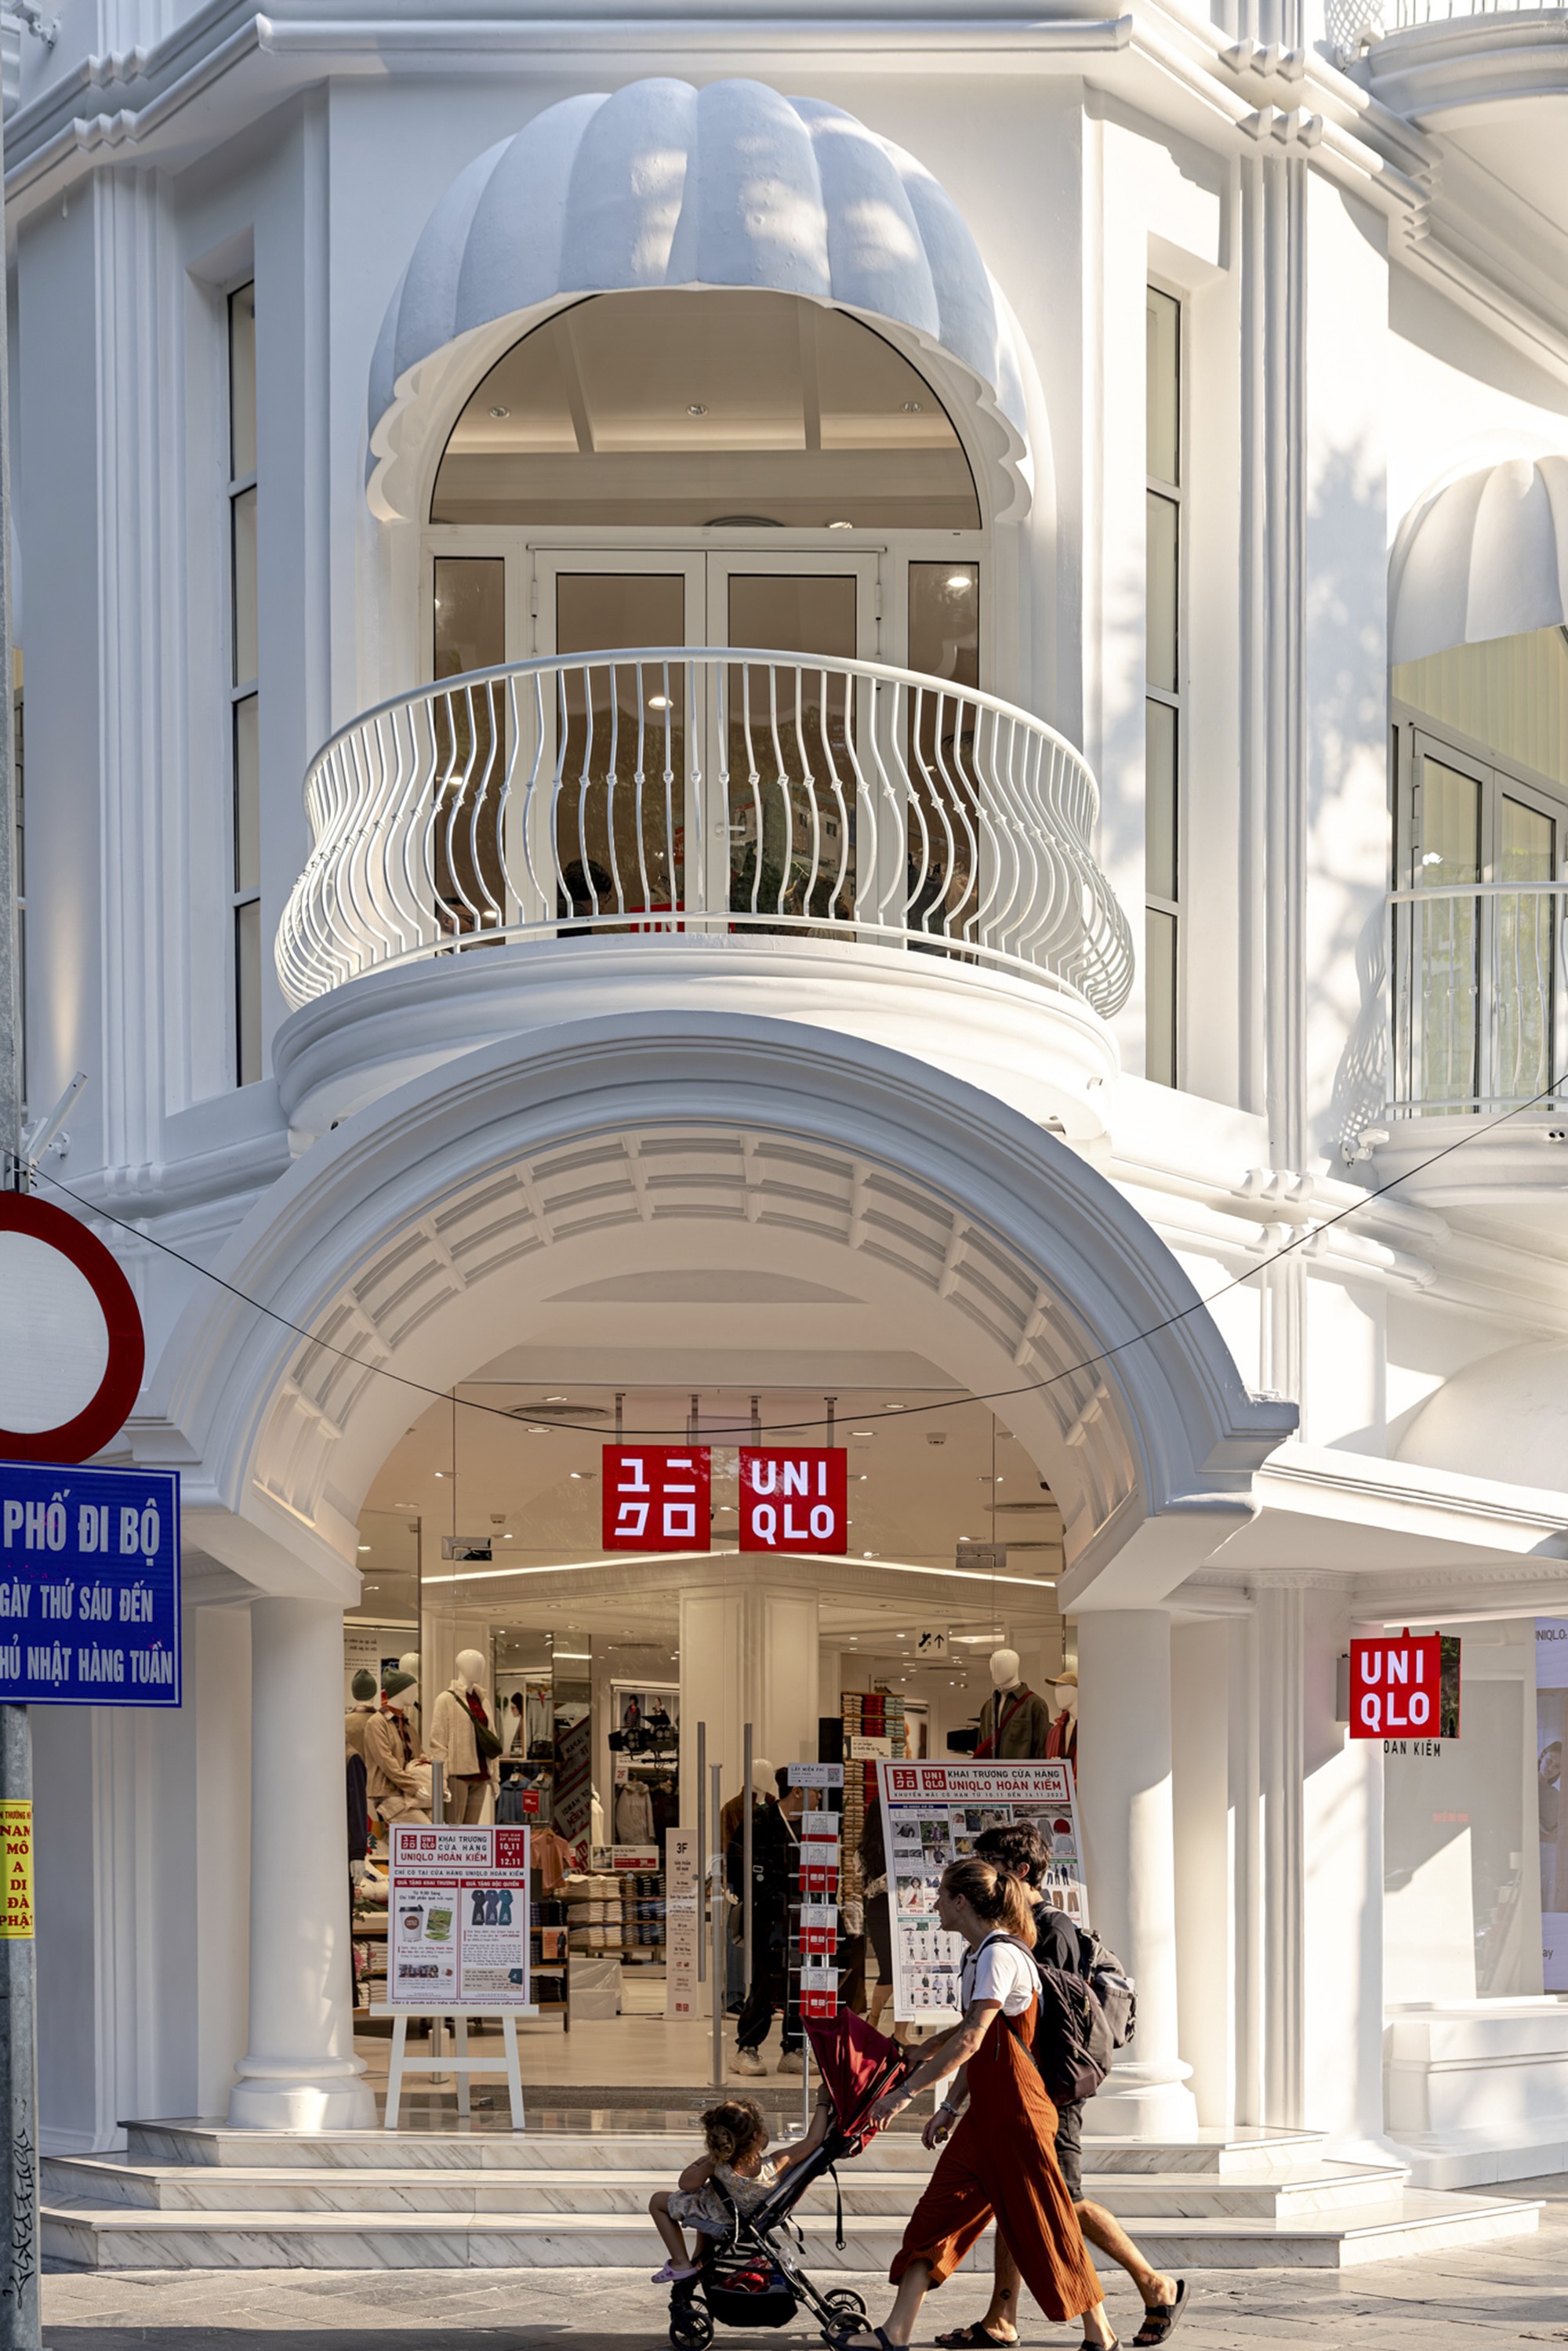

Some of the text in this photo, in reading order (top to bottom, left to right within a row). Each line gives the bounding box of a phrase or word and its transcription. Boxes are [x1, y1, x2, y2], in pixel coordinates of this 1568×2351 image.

[752, 1461, 826, 1496] UNI
[4, 1489, 160, 1566] PHỐ ĐI BỘ
[752, 1504, 834, 1544] QLO
[40, 1577, 74, 1620] THỨ
[79, 1580, 112, 1621] SÁU
[119, 1580, 153, 1623] ĐẾN
[1535, 1629, 1567, 1642] NIQLO:
[27, 1640, 71, 1687] NHẬT
[78, 1642, 124, 1682] HÀNG
[129, 1641, 172, 1684] TUẦN
[1361, 1649, 1424, 1685] UNI
[1361, 1691, 1430, 1732] QLO
[1035, 1769, 1060, 1778] HÀNG
[925, 1780, 945, 1790] QLO
[949, 1776, 1062, 1791] UNIQLO HOÀN KIẾM
[6, 1840, 29, 1855] MÔ
[463, 1843, 488, 1852] HÀNG
[677, 1842, 688, 1854] 3F
[401, 1850, 488, 1863] UNIQLO HOÀN KIẾM
[13, 1861, 24, 1873] A
[10, 1879, 27, 1890] DI
[7, 1894, 30, 1909] ĐÀ
[1542, 1949, 1554, 1961] ay
